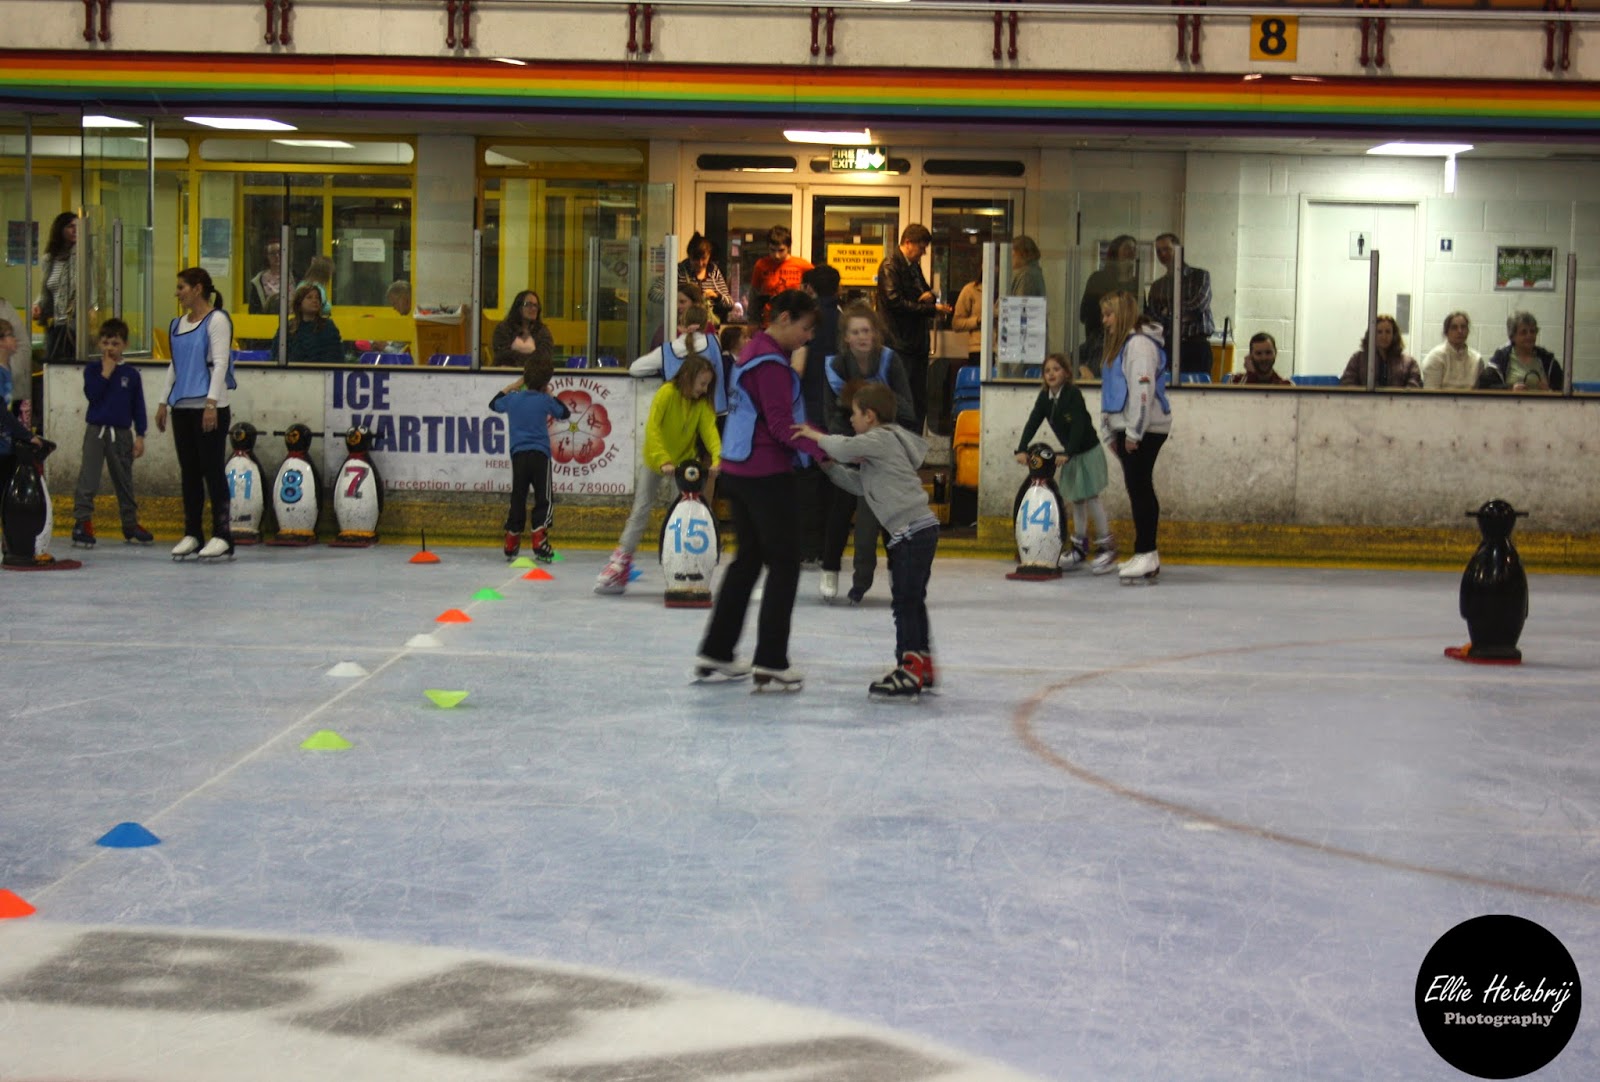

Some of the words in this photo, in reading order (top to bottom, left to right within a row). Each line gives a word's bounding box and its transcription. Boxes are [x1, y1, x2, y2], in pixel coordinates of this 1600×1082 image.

[1259, 18, 1287, 55] 8
[832, 149, 855, 159] FIRE
[832, 159, 855, 169] EXIT
[333, 370, 389, 411] ICE
[546, 377, 574, 392] OHN
[580, 378, 611, 400] NIKE
[485, 460, 510, 469] HERE
[552, 443, 620, 477] URESPORT
[281, 470, 303, 503] 8
[344, 466, 370, 499] 7
[394, 479, 450, 491] reception
[454, 482, 466, 490] or
[473, 480, 494, 491] call
[498, 483, 511, 492] us
[580, 482, 626, 494] 789000
[1021, 500, 1055, 533] 14
[669, 517, 710, 555] 15
